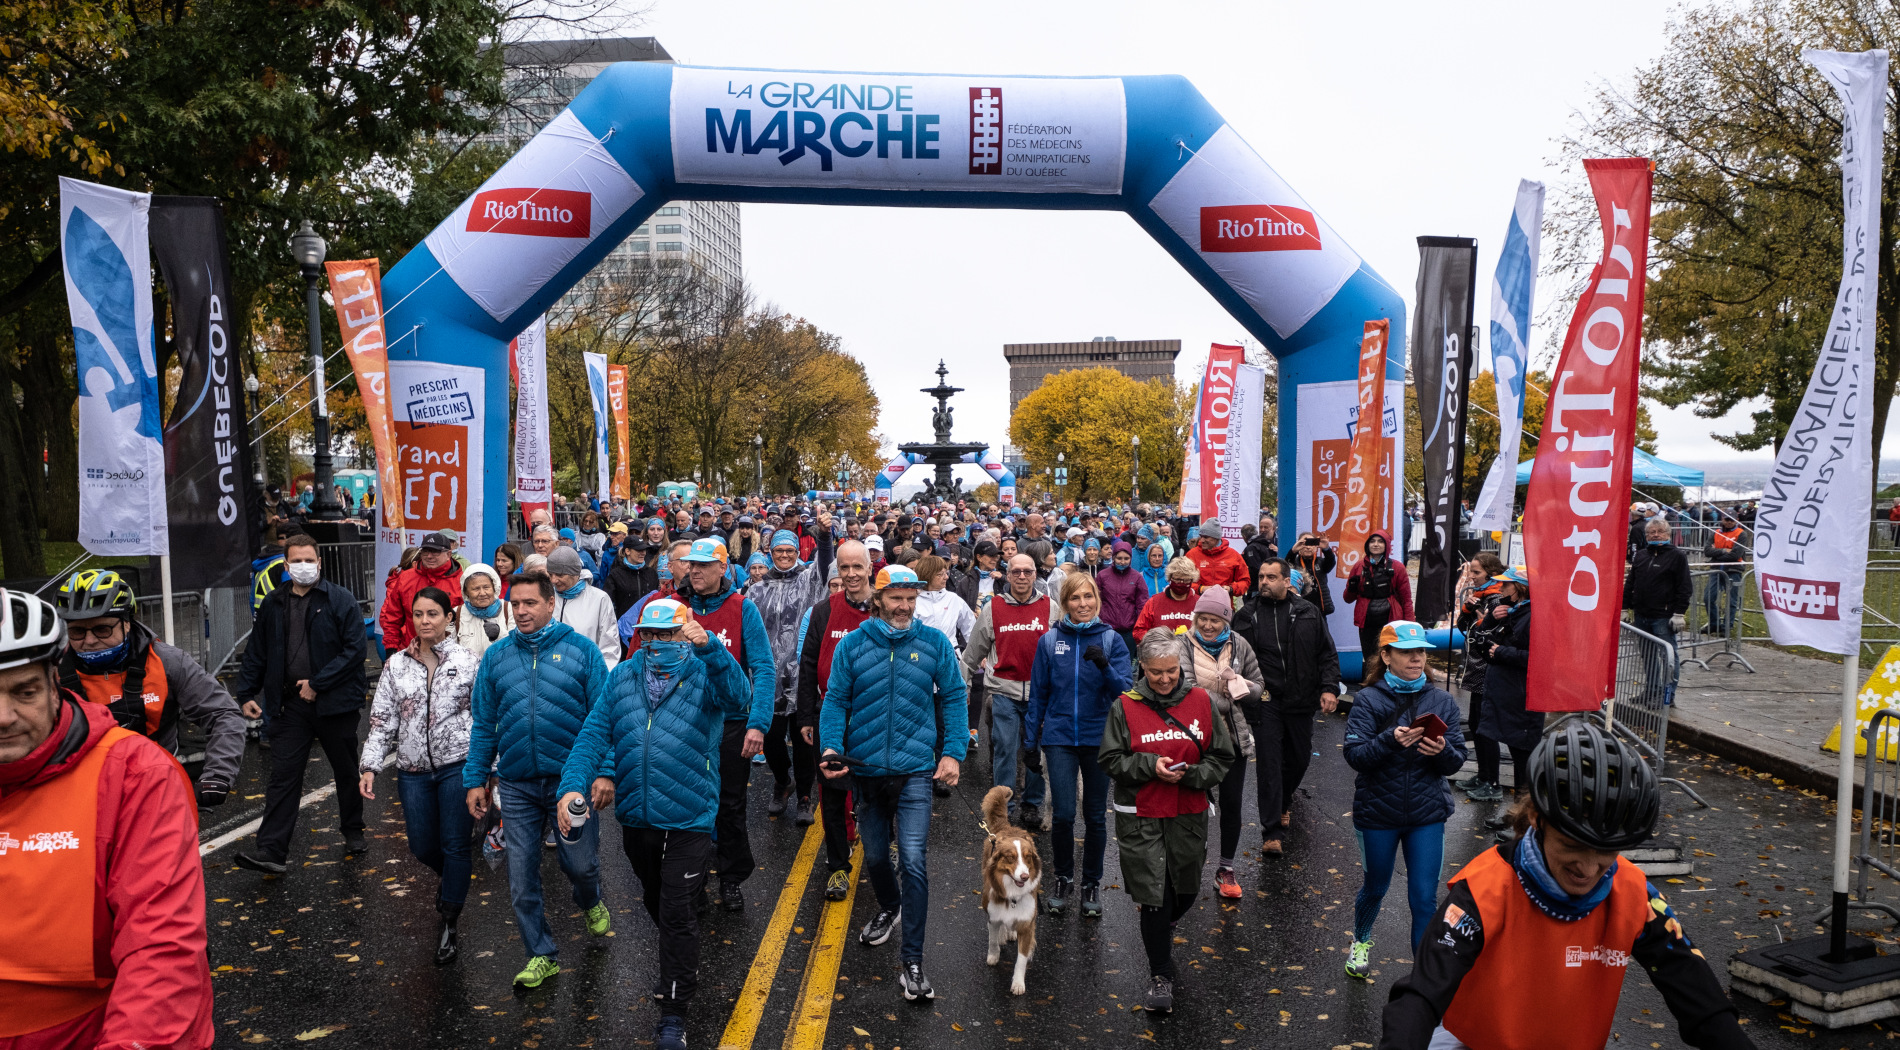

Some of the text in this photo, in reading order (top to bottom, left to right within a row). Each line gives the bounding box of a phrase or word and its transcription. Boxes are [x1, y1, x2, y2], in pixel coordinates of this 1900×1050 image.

[728, 81, 913, 111] LA GRANDE
[1008, 123, 1072, 135] FÉDÉRATION
[705, 108, 940, 171] MARCHE
[1007, 138, 1083, 149] DES MÉDECINS
[1007, 153, 1091, 164] OMNIPRATICIENS
[1007, 167, 1067, 177] DU QUÉBEC
[409, 377, 458, 397] PRESCRIT
[414, 402, 467, 421] MÉDECINS
[437, 417, 459, 426] FAMILLE
[397, 439, 460, 468] rand
[1319, 446, 1335, 460] le
[1318, 452, 1391, 489] grd
[404, 468, 459, 520] ÉFI
[1317, 487, 1390, 533] DI
[36, 831, 74, 841] GRANDE
[22, 838, 80, 853] MARCHE
